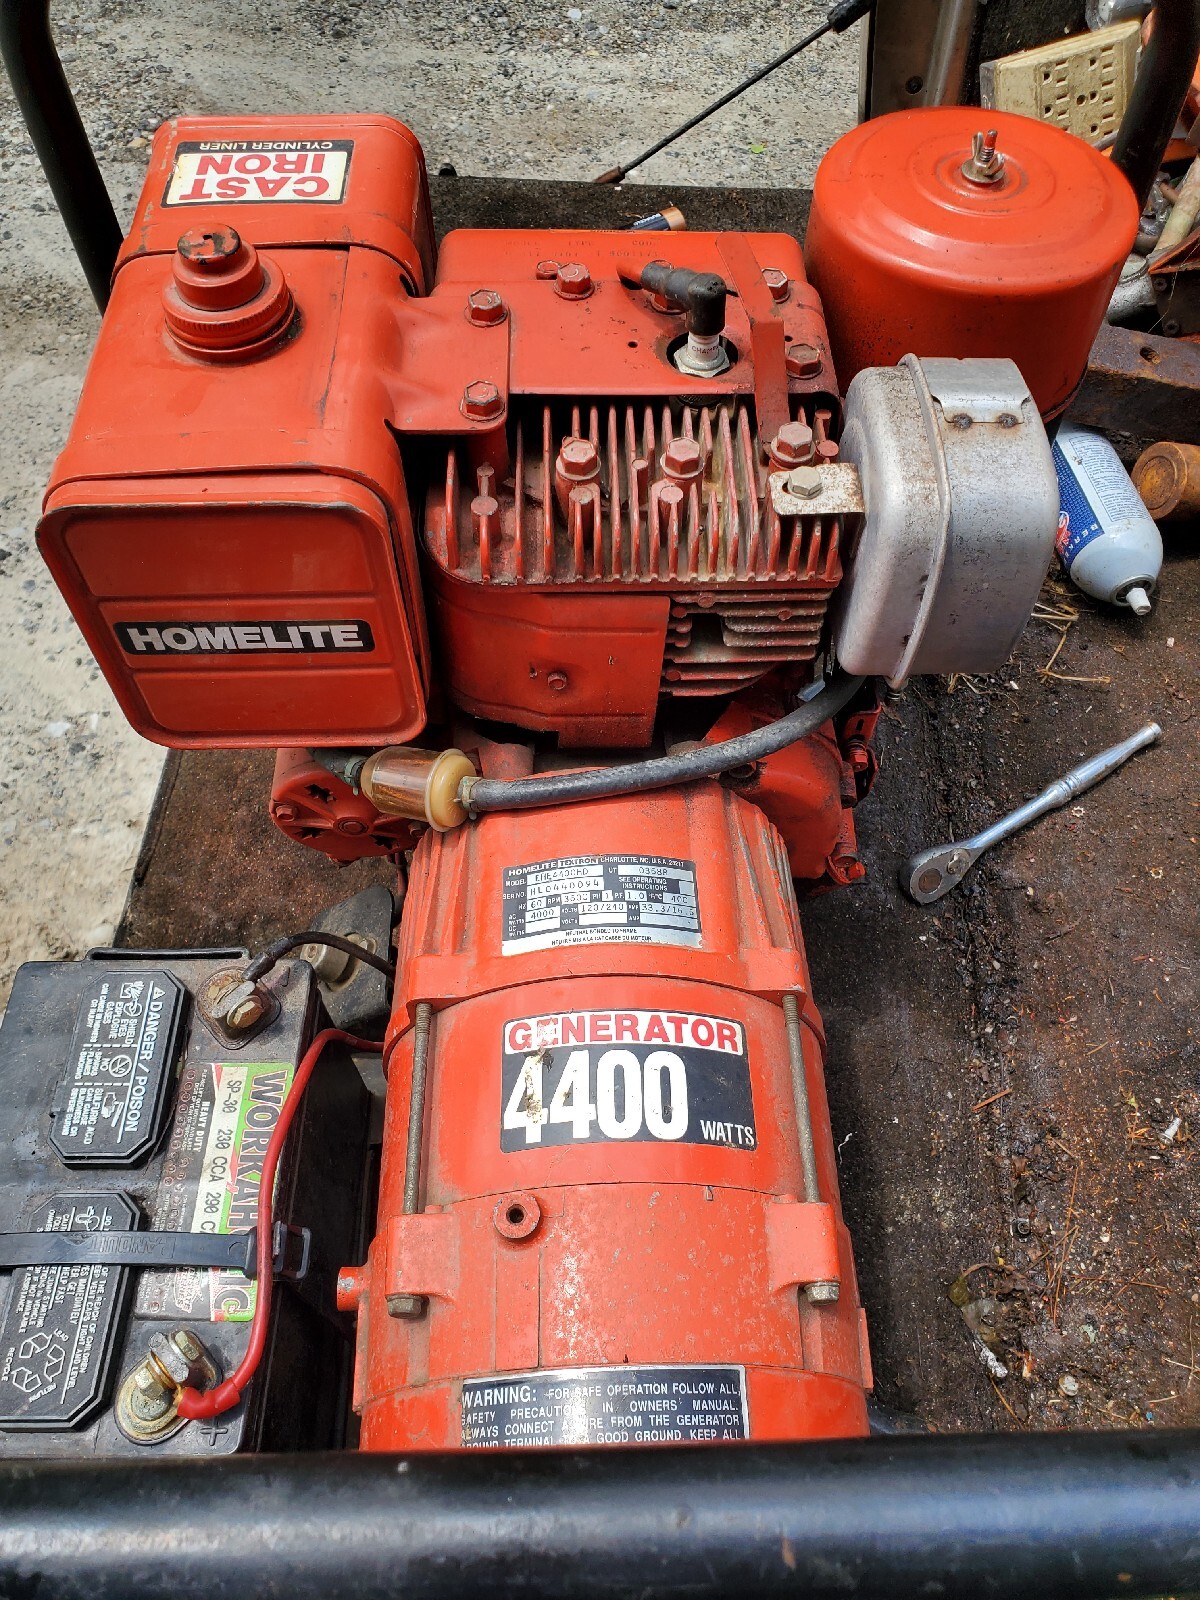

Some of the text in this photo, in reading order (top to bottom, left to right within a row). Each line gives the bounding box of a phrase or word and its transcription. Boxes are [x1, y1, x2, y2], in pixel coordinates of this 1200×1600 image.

[199, 141, 333, 150] CYLINDER LINER
[196, 154, 326, 175] IRON
[179, 176, 330, 200] CAST
[127, 624, 364, 651] HOMELITE
[508, 861, 557, 877] HOMELITE
[560, 857, 597, 867] TEXTRON
[502, 892, 514, 900] SER
[632, 876, 667, 885] OPERATING
[622, 882, 668, 891] INSTRUCTIONS
[530, 900, 542, 908] 60
[548, 896, 560, 904] RPM
[628, 892, 644, 900] 1.0
[530, 908, 554, 920] 4000
[582, 903, 624, 912] 120/240
[102, 1002, 114, 1024] GASES
[108, 1002, 124, 1039] EXPLOSIVE
[118, 1018, 130, 1037] EYES
[124, 1018, 138, 1044] SHIELD
[140, 1002, 162, 1060] DANGER
[508, 1014, 739, 1052] GENERATOR
[100, 1058, 110, 1071] NO
[85, 1088, 94, 1102] CAN
[124, 1076, 148, 1132] POISON
[503, 1049, 755, 1146] 4400 WATTS
[84, 1088, 104, 1144] SULFURIC ACID
[193, 1101, 210, 1152] HEAVY DUTY
[200, 1079, 242, 1233] SP-30 230 CCA 290 C
[55, 1266, 70, 1304] HELP FAST
[66, 1282, 77, 1296] GET
[28, 1298, 41, 1326] VEHICLE
[36, 1296, 50, 1328] STARTING
[70, 1279, 87, 1324] IMMEDIATELY
[66, 1265, 102, 1390] EEP VENT CAPS TIGHT AND LEVEL
[79, 1267, 108, 1373] OF THE REACH OF CHILDREN
[54, 1328, 69, 1342] LEAD
[2, 1347, 15, 1382] RECYCLE
[28, 1383, 57, 1403] RETURN
[462, 1382, 714, 1409] WARNING: FOR SAFE OPERATION FOLLOW
[462, 1410, 496, 1426] SAFETY
[602, 1402, 614, 1412] IN
[692, 1400, 738, 1410] MANUAL.
[504, 1421, 554, 1436] CONNECT
[562, 1420, 569, 1431] A
[610, 1416, 642, 1428] FROM
[648, 1414, 670, 1426] THE
[676, 1414, 740, 1426] GENERATOR
[596, 1432, 629, 1444] GOOD
[690, 1428, 717, 1440] KEEP
[723, 1428, 741, 1440] ALL
